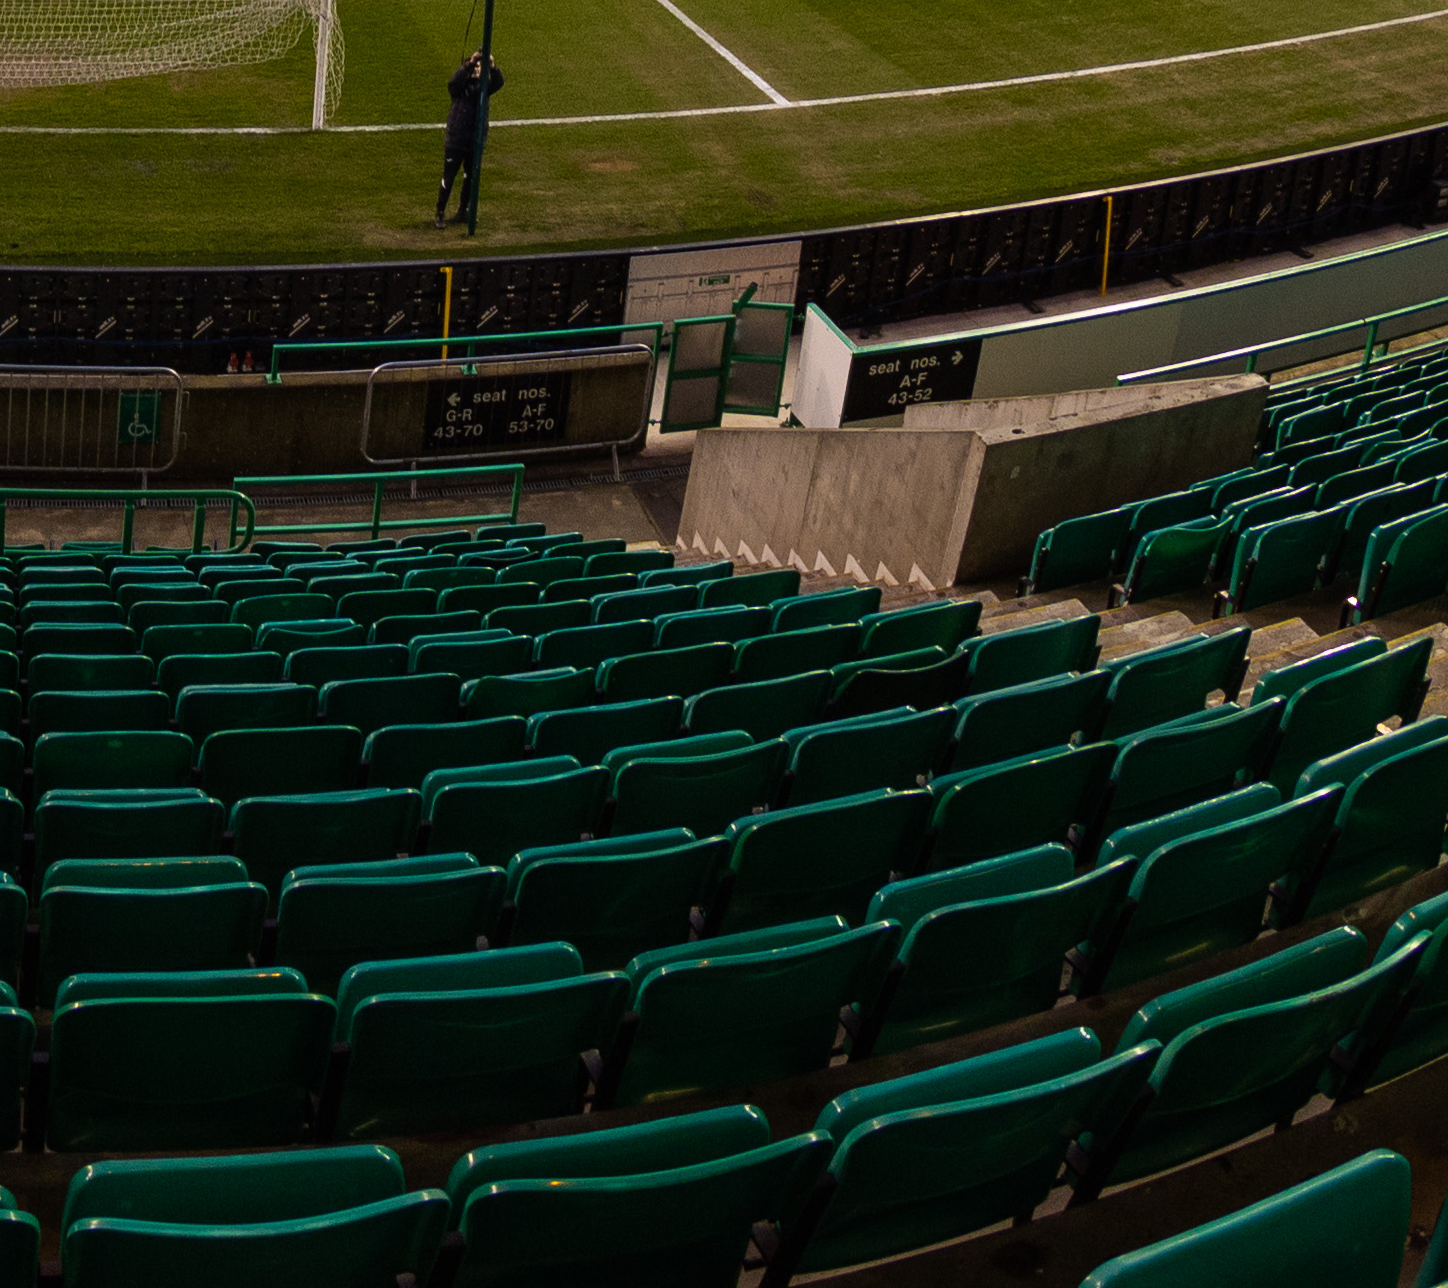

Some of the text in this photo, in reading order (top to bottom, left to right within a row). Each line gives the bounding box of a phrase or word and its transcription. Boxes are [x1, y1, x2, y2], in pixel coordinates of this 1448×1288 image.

[869, 355, 941, 376] seat nos.
[899, 372, 928, 388] A-F
[473, 387, 551, 403] seat nos.
[888, 388, 933, 405] 43-52
[446, 403, 546, 422] G-R A-F
[434, 418, 554, 438] 43-70 53-70
